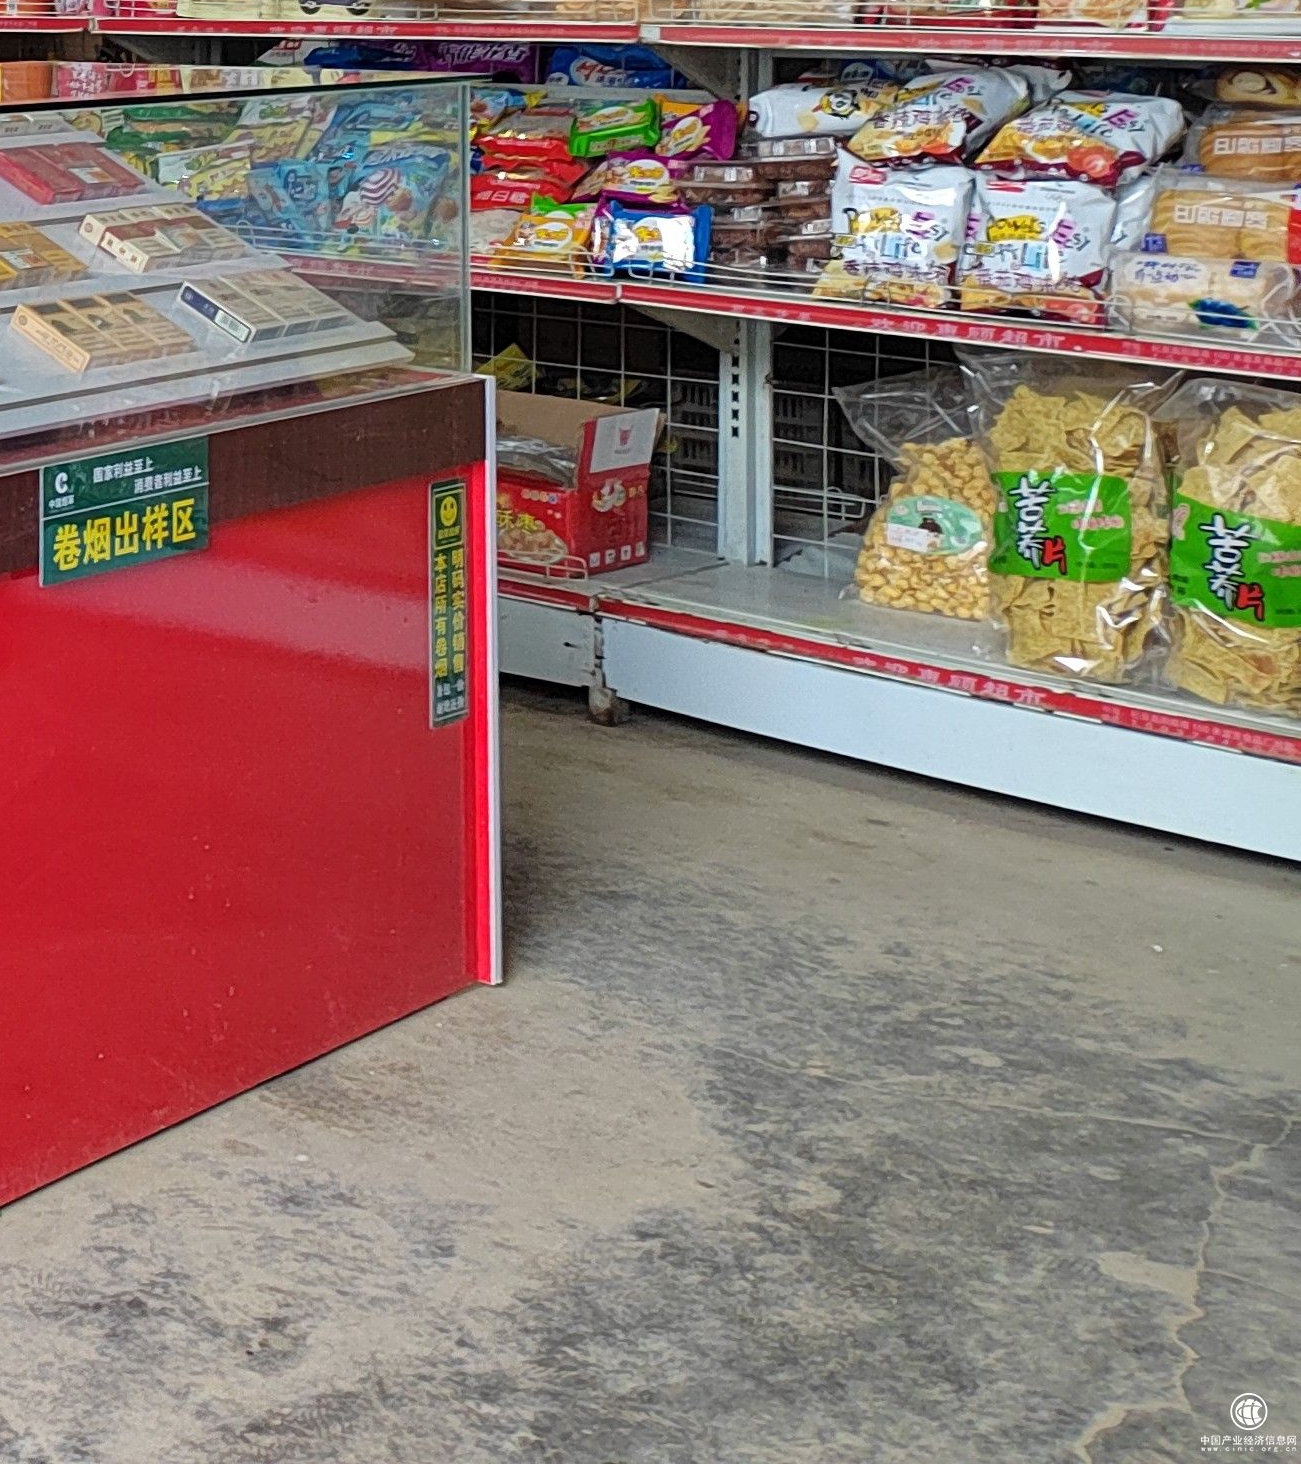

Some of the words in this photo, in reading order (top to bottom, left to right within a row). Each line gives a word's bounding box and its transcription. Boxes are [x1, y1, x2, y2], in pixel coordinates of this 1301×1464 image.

[93, 457, 155, 484] 国家利益至上
[134, 466, 203, 495] 消费者利益至上
[52, 498, 197, 572] 卷烟出样区
[433, 552, 449, 678] 本店所有卷烟
[450, 549, 466, 674] 明码实价销售
